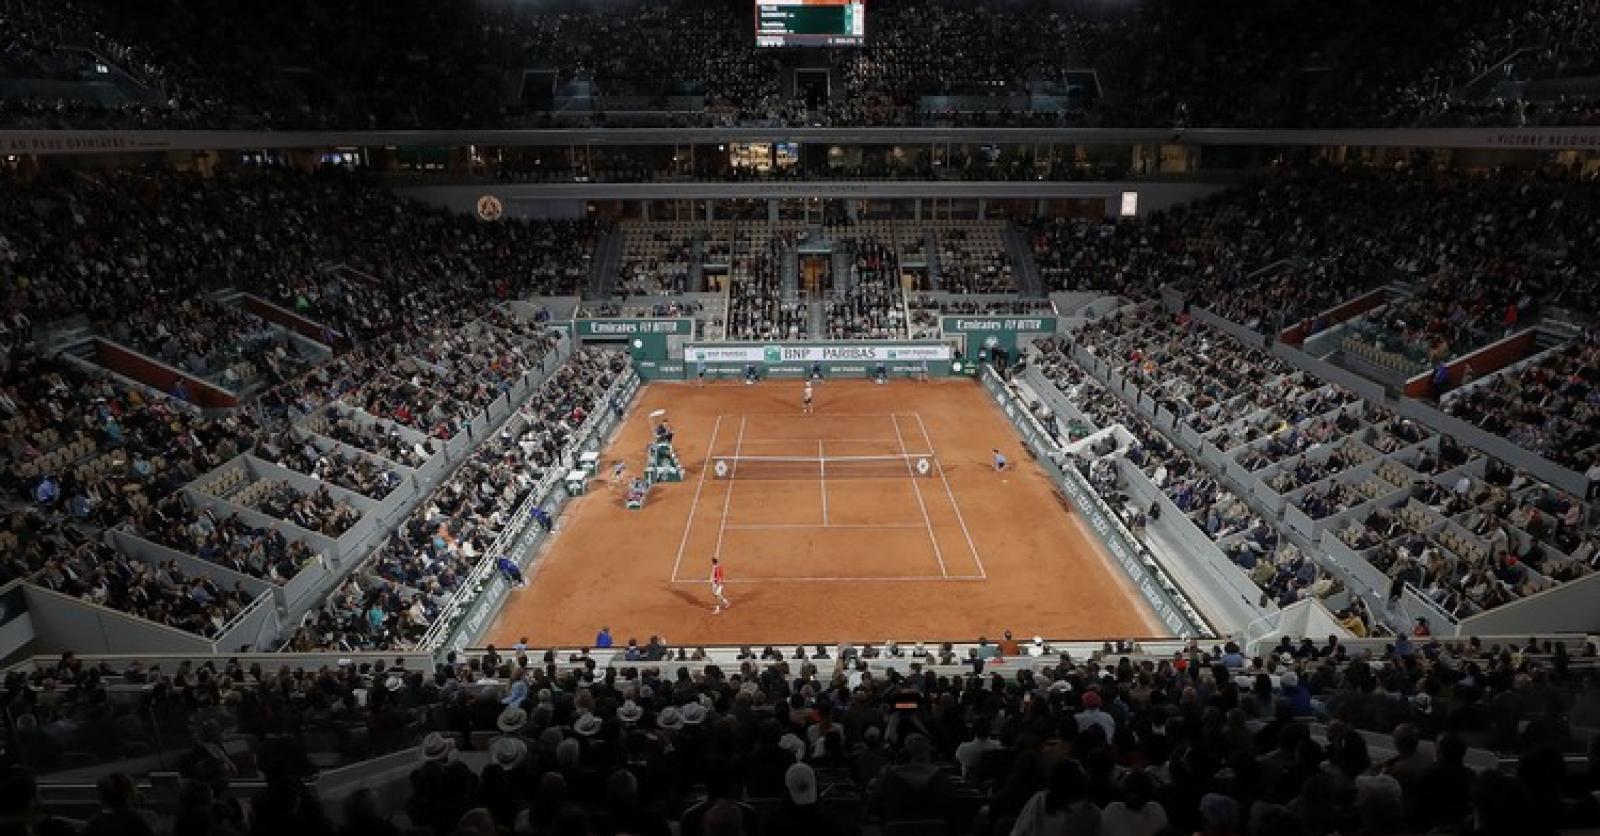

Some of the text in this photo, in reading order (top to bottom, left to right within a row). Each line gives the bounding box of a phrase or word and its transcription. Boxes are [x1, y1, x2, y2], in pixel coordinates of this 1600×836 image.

[590, 321, 637, 333] Emirates
[957, 319, 1001, 330] Emirates
[784, 347, 876, 359] BNP PARIBAS
